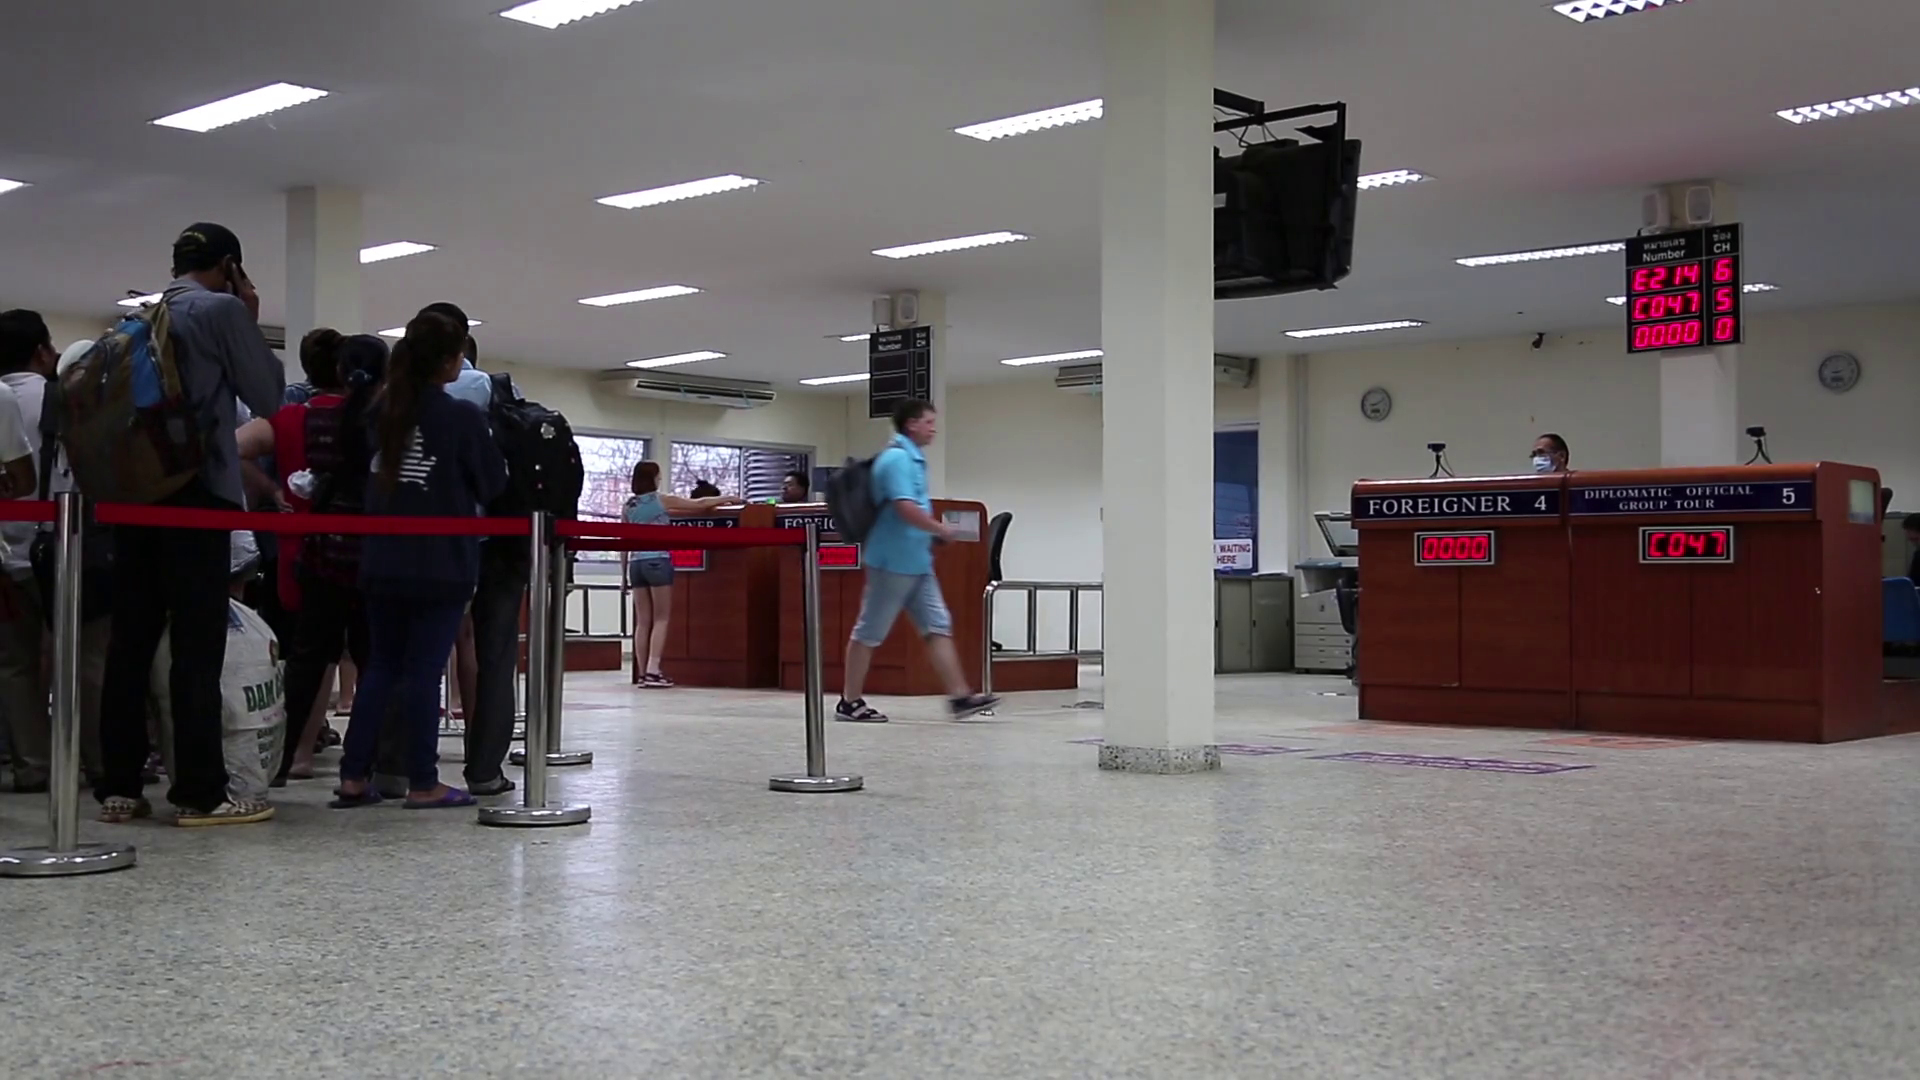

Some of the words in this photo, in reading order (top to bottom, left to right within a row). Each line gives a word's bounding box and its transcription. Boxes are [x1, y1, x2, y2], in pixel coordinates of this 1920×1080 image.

[1642, 250, 1686, 262] Number
[1713, 242, 1731, 253] CH
[1632, 263, 1700, 292] E214
[1714, 257, 1733, 282] 6
[1632, 291, 1700, 320] C047
[1715, 286, 1733, 312] 5
[1634, 319, 1701, 348] 0000
[1584, 487, 1672, 499] DIPLOMATIC
[1686, 485, 1753, 496] OFFICIAL
[1782, 487, 1796, 504] 5
[1368, 496, 1512, 514] FOREIGNER
[1534, 495, 1547, 511] 4
[1619, 499, 1668, 510] GROUP
[1676, 499, 1715, 509] TOUR
[1219, 544, 1251, 553] WAITING
[1423, 536, 1488, 560] 0000
[1649, 531, 1726, 557] C047
[1216, 555, 1237, 564] HERE
